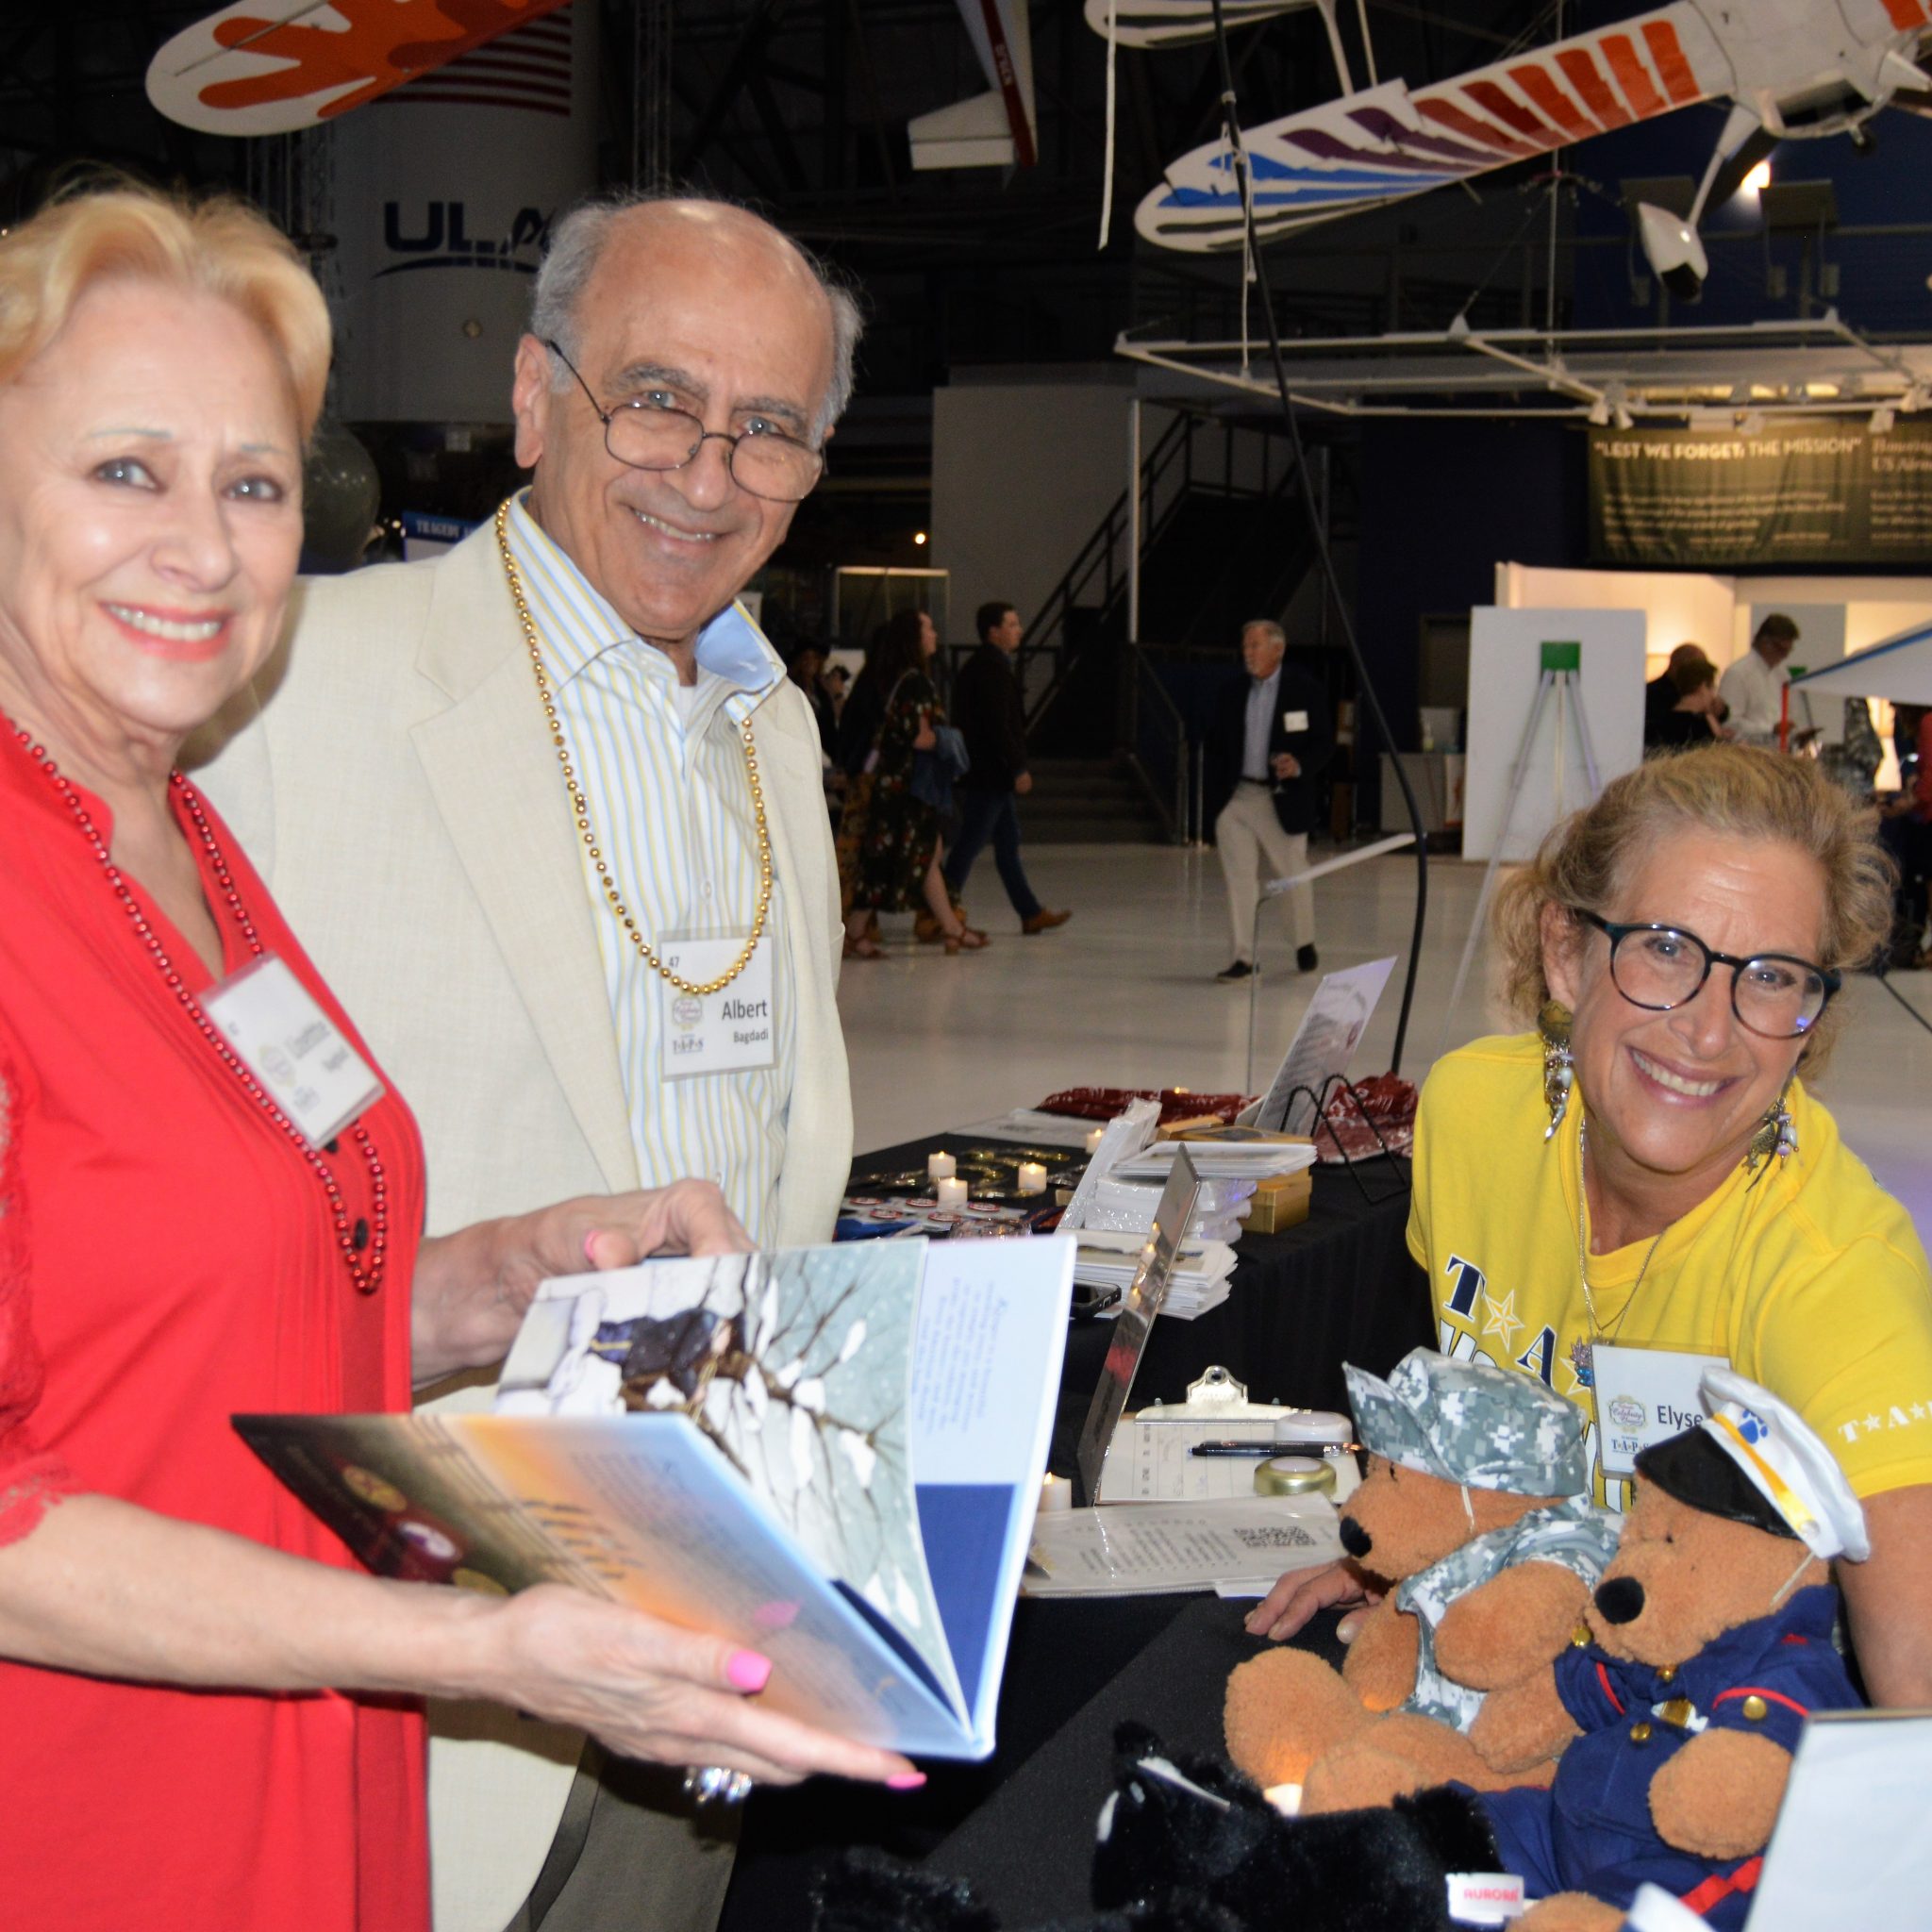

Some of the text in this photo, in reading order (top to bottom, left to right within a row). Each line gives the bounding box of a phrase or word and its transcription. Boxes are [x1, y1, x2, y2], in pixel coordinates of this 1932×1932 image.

[384, 201, 553, 256] ULA
[1644, 441, 1672, 459] WE
[1748, 440, 1781, 457] THE
[669, 956, 680, 968] 47
[722, 999, 768, 1020] Albert
[733, 1029, 769, 1044] Bagdadi
[1657, 1405, 1704, 1430] Elyse
